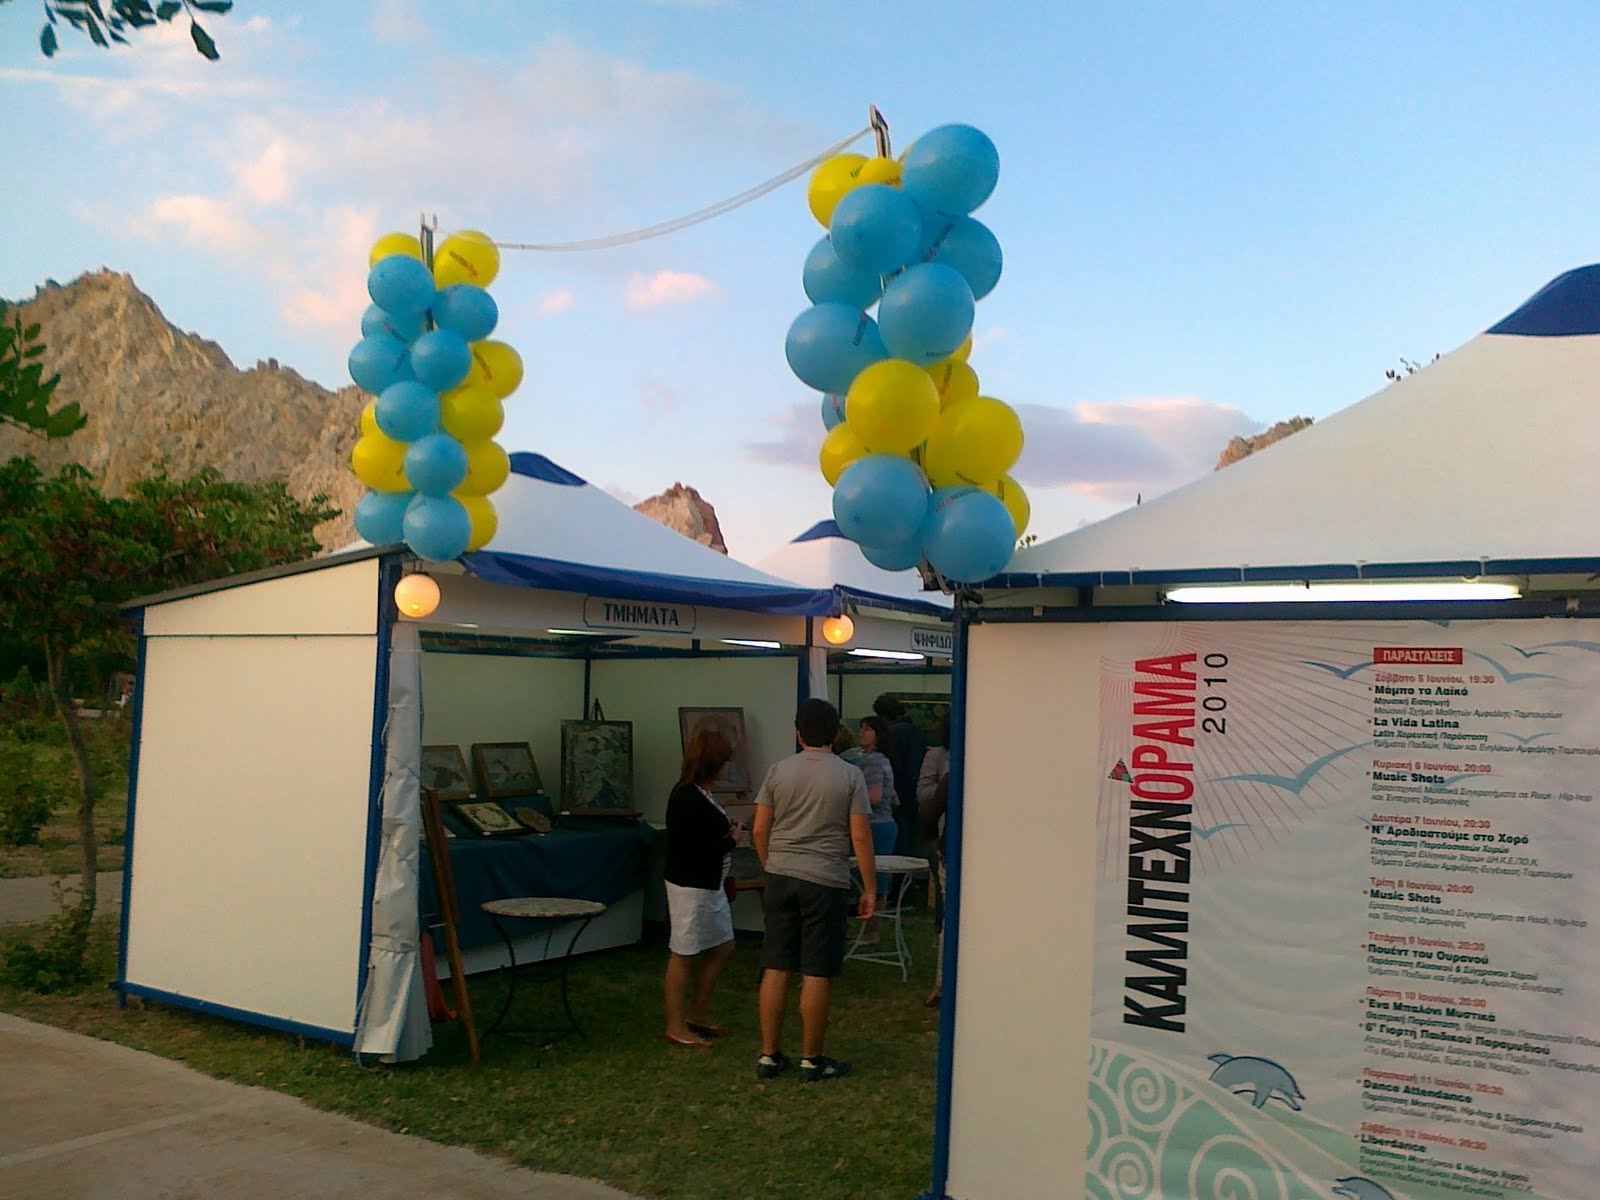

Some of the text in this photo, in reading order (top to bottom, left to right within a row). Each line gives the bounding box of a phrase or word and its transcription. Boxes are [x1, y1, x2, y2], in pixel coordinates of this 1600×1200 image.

[603, 603, 679, 626] ΤΜΗΜΑΤΑ
[1383, 650, 1454, 662] ΠΑΡΑΣΤΑΣΕΙΣ
[1469, 675, 1494, 684] 19:30
[1201, 653, 1228, 734] 2010
[1375, 685, 1415, 696] Μάμπο
[1374, 717, 1459, 728] La Vida Latina
[1373, 760, 1412, 771] Κυριακή
[1465, 763, 1491, 773] 20:00
[1373, 771, 1445, 783] Music Shots
[1123, 653, 1197, 1033] ΚΑΛΛΙΤΕΧΝΟΡΑΜΑ
[1387, 826, 1469, 841] Αραδιαστούμε
[1473, 834, 1494, 842] στο
[1498, 833, 1529, 845] Χορό
[1370, 889, 1441, 904] Music Shots
[1368, 944, 1488, 965] Πουέντ του Ουρανού
[1363, 1079, 1472, 1103] Dance Attendance
[1361, 1134, 1426, 1152] Liberdance
